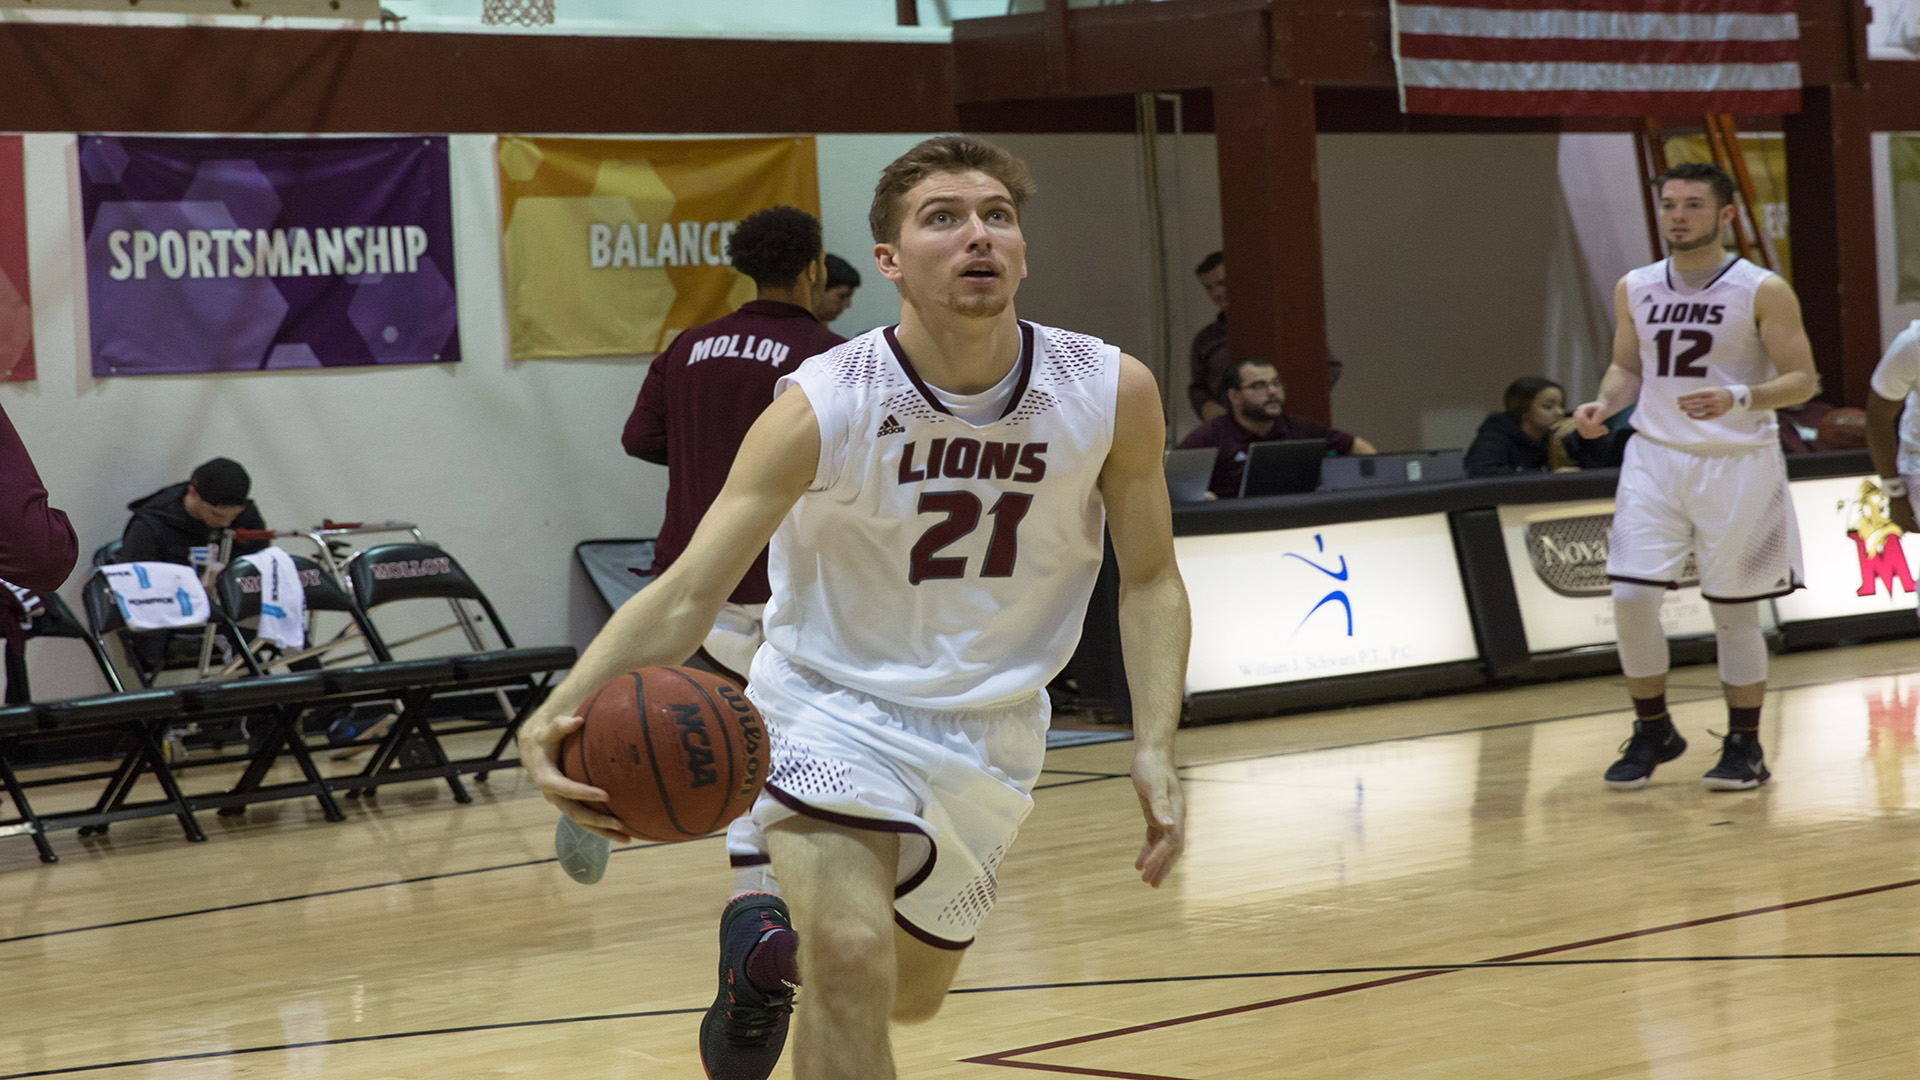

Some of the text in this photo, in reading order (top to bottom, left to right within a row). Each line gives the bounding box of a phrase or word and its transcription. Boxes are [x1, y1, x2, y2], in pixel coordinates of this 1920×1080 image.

[108, 226, 428, 280] SPORTSMANSHIP
[589, 221, 735, 268] BALANCE
[1646, 303, 1725, 325] LIONS
[687, 334, 790, 367] MOLLOY
[1653, 329, 1712, 377] 12
[877, 426, 905, 437] adidas
[898, 437, 1048, 485] LIONS
[908, 490, 1034, 586] 21
[1541, 530, 1611, 567] Nova
[369, 557, 450, 580] MOLLOY
[670, 704, 718, 788] NCAA
